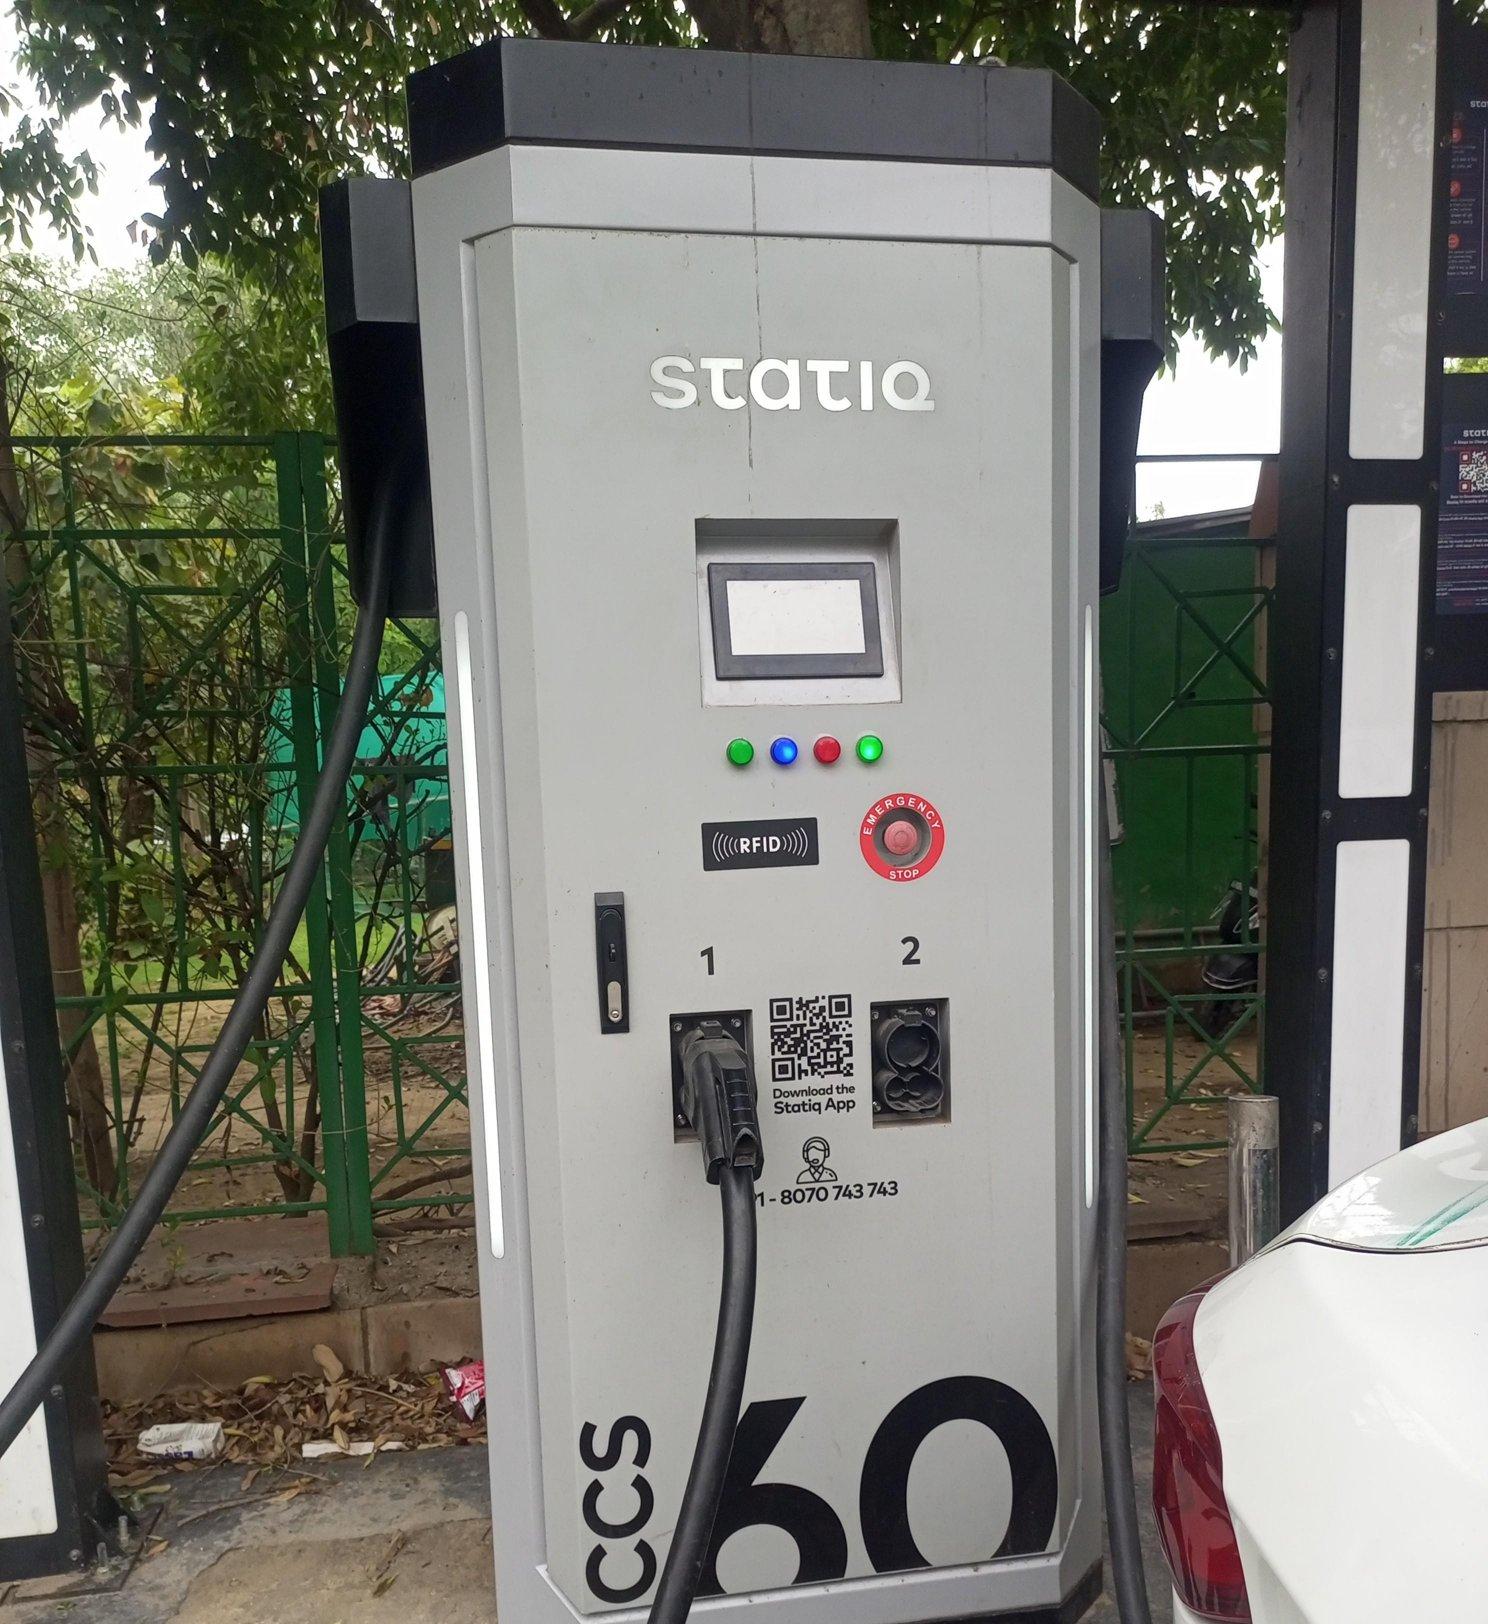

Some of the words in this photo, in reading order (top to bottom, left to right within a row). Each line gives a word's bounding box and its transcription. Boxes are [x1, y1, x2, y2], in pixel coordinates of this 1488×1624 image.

[1470, 100, 1488, 108] sta
[863, 797, 941, 835] EMERGENCY
[739, 836, 781, 854] RFID
[889, 869, 920, 880] STOP
[700, 946, 715, 976] 1
[900, 936, 921, 966] 2
[772, 1084, 833, 1099] Download
[835, 1084, 856, 1095] the
[773, 1099, 822, 1115] Statiq
[824, 1098, 856, 1113] App
[780, 1186, 829, 1206] 8070
[832, 1183, 864, 1201] 743
[866, 1180, 899, 1198] 743
[694, 1375, 1058, 1599] 60
[579, 1415, 658, 1603] CCS
